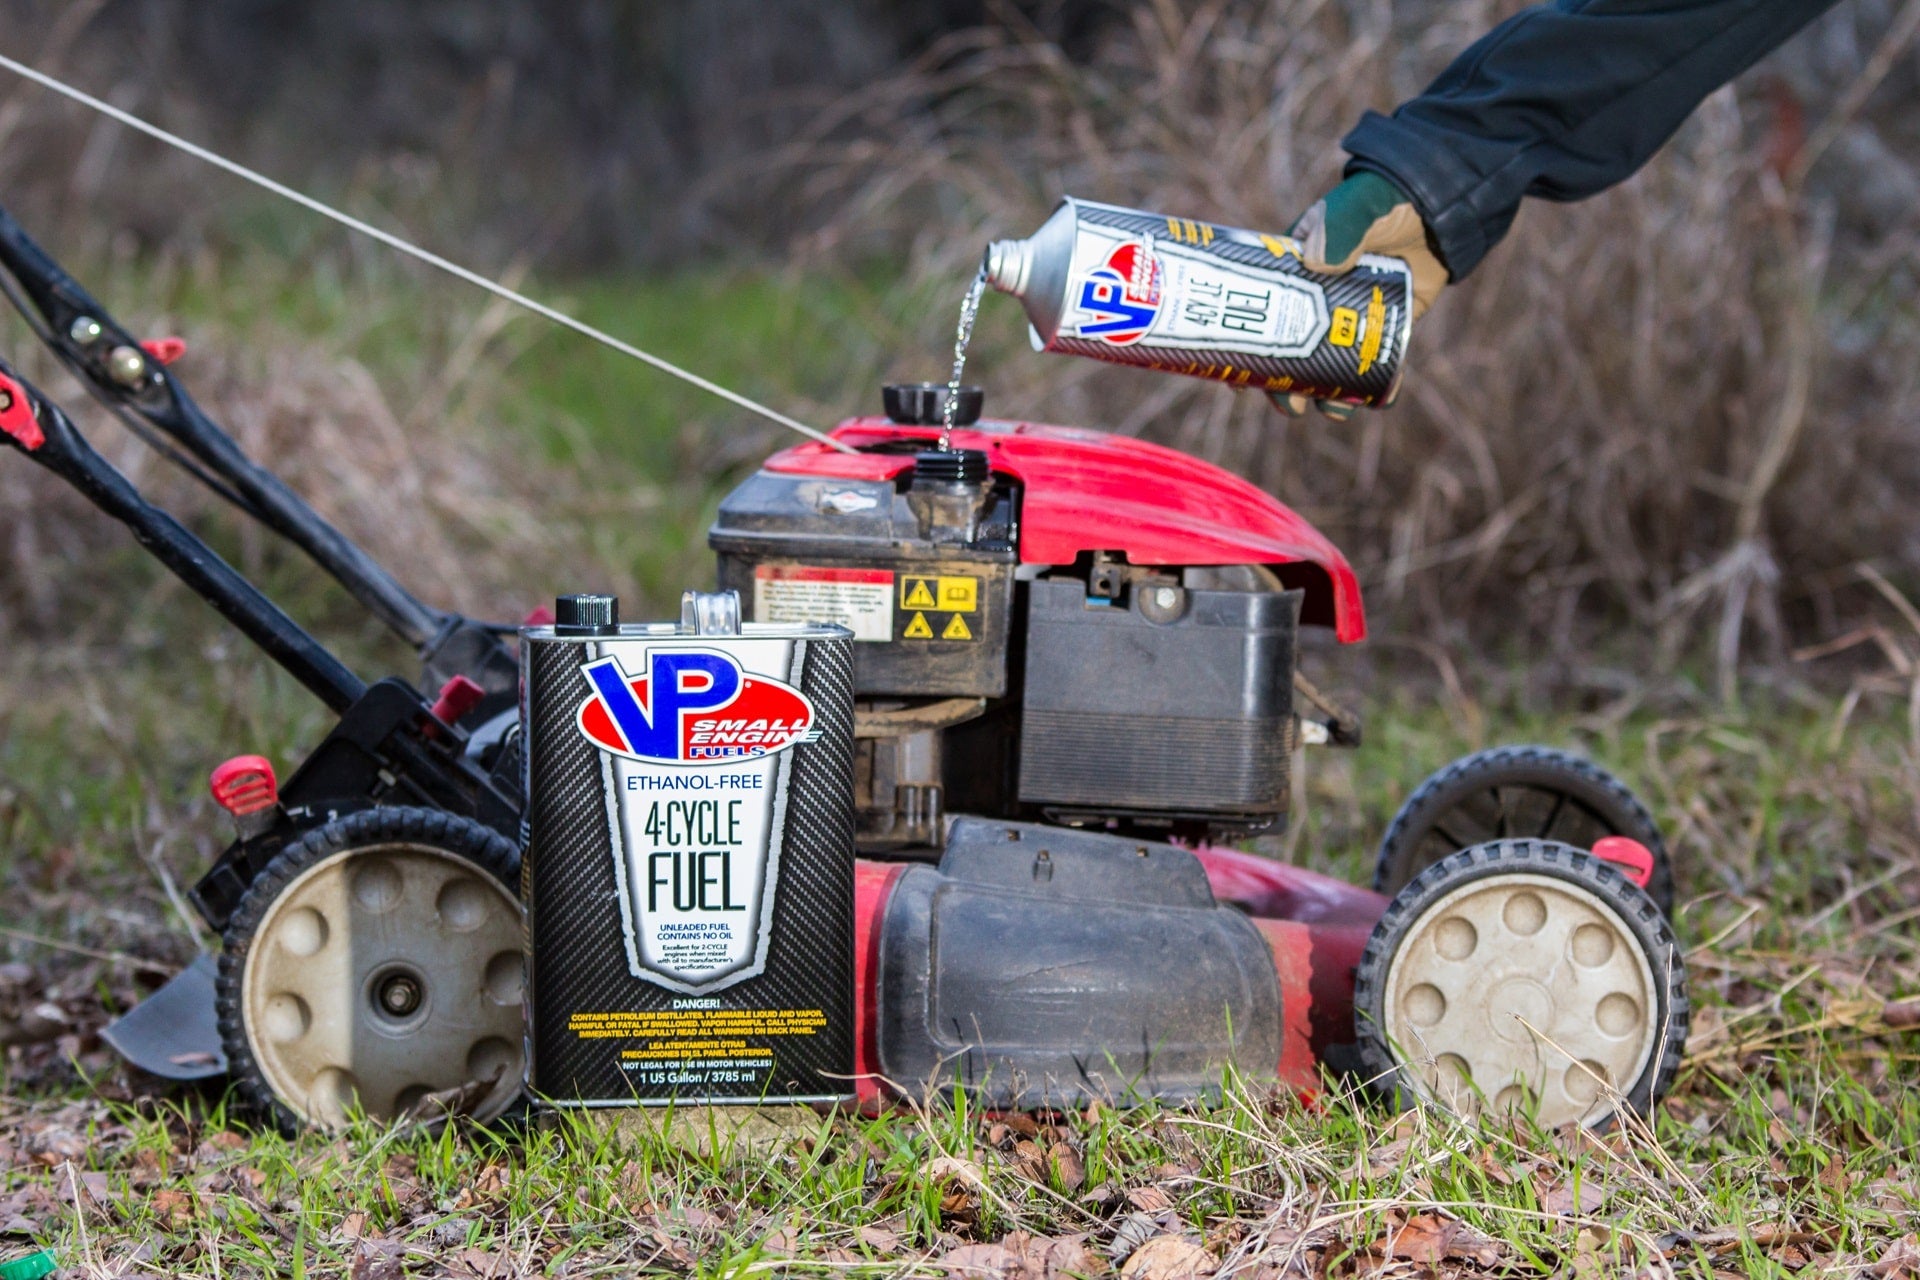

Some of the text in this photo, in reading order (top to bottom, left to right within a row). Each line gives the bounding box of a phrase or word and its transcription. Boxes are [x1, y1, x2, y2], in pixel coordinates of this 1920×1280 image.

[1079, 270, 1156, 335] VP
[585, 652, 741, 760] VP
[690, 718, 805, 731] SMALL
[689, 730, 824, 743] ENGINE
[689, 746, 767, 758] FUELS
[626, 774, 763, 791] ETHANOL-FREE
[644, 799, 743, 847] 4-CYCLE
[647, 851, 746, 913] FUEL
[660, 923, 731, 932] UNLEADED FUEL
[657, 932, 734, 941] CONTAINS NO OIL
[691, 943, 700, 951] for
[673, 999, 720, 1010] DANGER!
[571, 1013, 609, 1022] CONTAINS
[610, 1012, 656, 1021] PETROLEUM
[706, 1010, 752, 1019] FLAMMABLE
[753, 1010, 778, 1018] LIQUID
[779, 1010, 795, 1018] AND
[796, 1009, 824, 1018] VAPOR.
[569, 1021, 605, 1030] HARMFUL
[606, 1021, 617, 1029] OR
[618, 1020, 641, 1029] FATAL
[642, 1020, 650, 1028] IF
[701, 1019, 727, 1027] VAPOR
[728, 1019, 765, 1027] HARMFUL.
[766, 1018, 786, 1026] CALL
[787, 1018, 827, 1026] PHYSICIAN
[579, 1026, 816, 1038] IMMEDIATELY. CAREFULLY READ ALL WARNINGS ON BACK PANEL.
[649, 1040, 746, 1050] LEA ATENTAMENTE OTRAS
[622, 1050, 680, 1059] PRECAUCIONES
[681, 1049, 692, 1058] EN
[703, 1049, 728, 1057] PANEL
[729, 1048, 774, 1057] POSTERIOR.
[623, 1061, 640, 1070] NOT
[640, 1061, 664, 1069] LEGAL
[665, 1060, 680, 1069] FOR
[696, 1060, 705, 1068] IN
[706, 1060, 734, 1068] MOTOR
[735, 1059, 773, 1068] VEHICLES!
[640, 1072, 647, 1084] 1
[649, 1072, 665, 1084] US
[703, 1070, 711, 1084] /
[711, 1070, 739, 1083] 3785
[741, 1068, 756, 1082] ml
